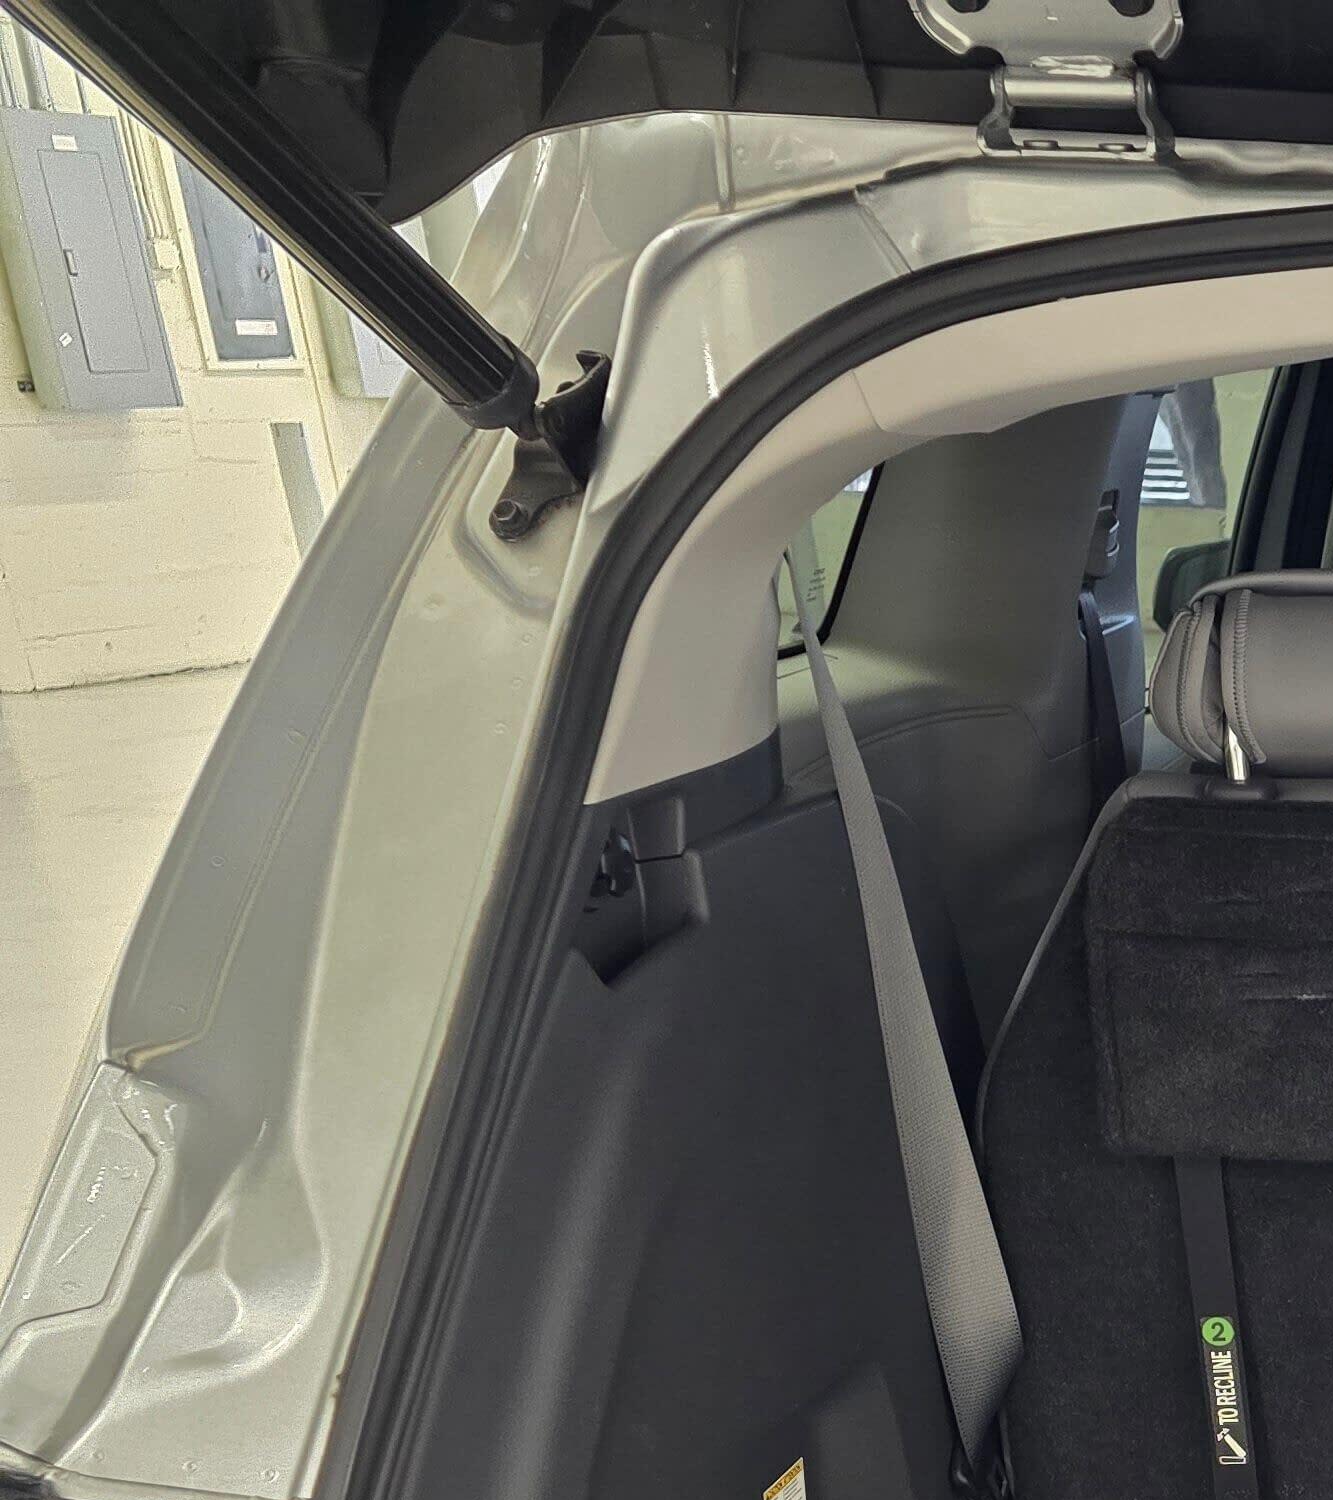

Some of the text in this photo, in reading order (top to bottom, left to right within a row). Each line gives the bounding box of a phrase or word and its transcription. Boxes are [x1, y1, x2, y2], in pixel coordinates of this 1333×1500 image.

[1211, 1322, 1226, 1341] 2
[1210, 1350, 1239, 1425] TO RECLINE
